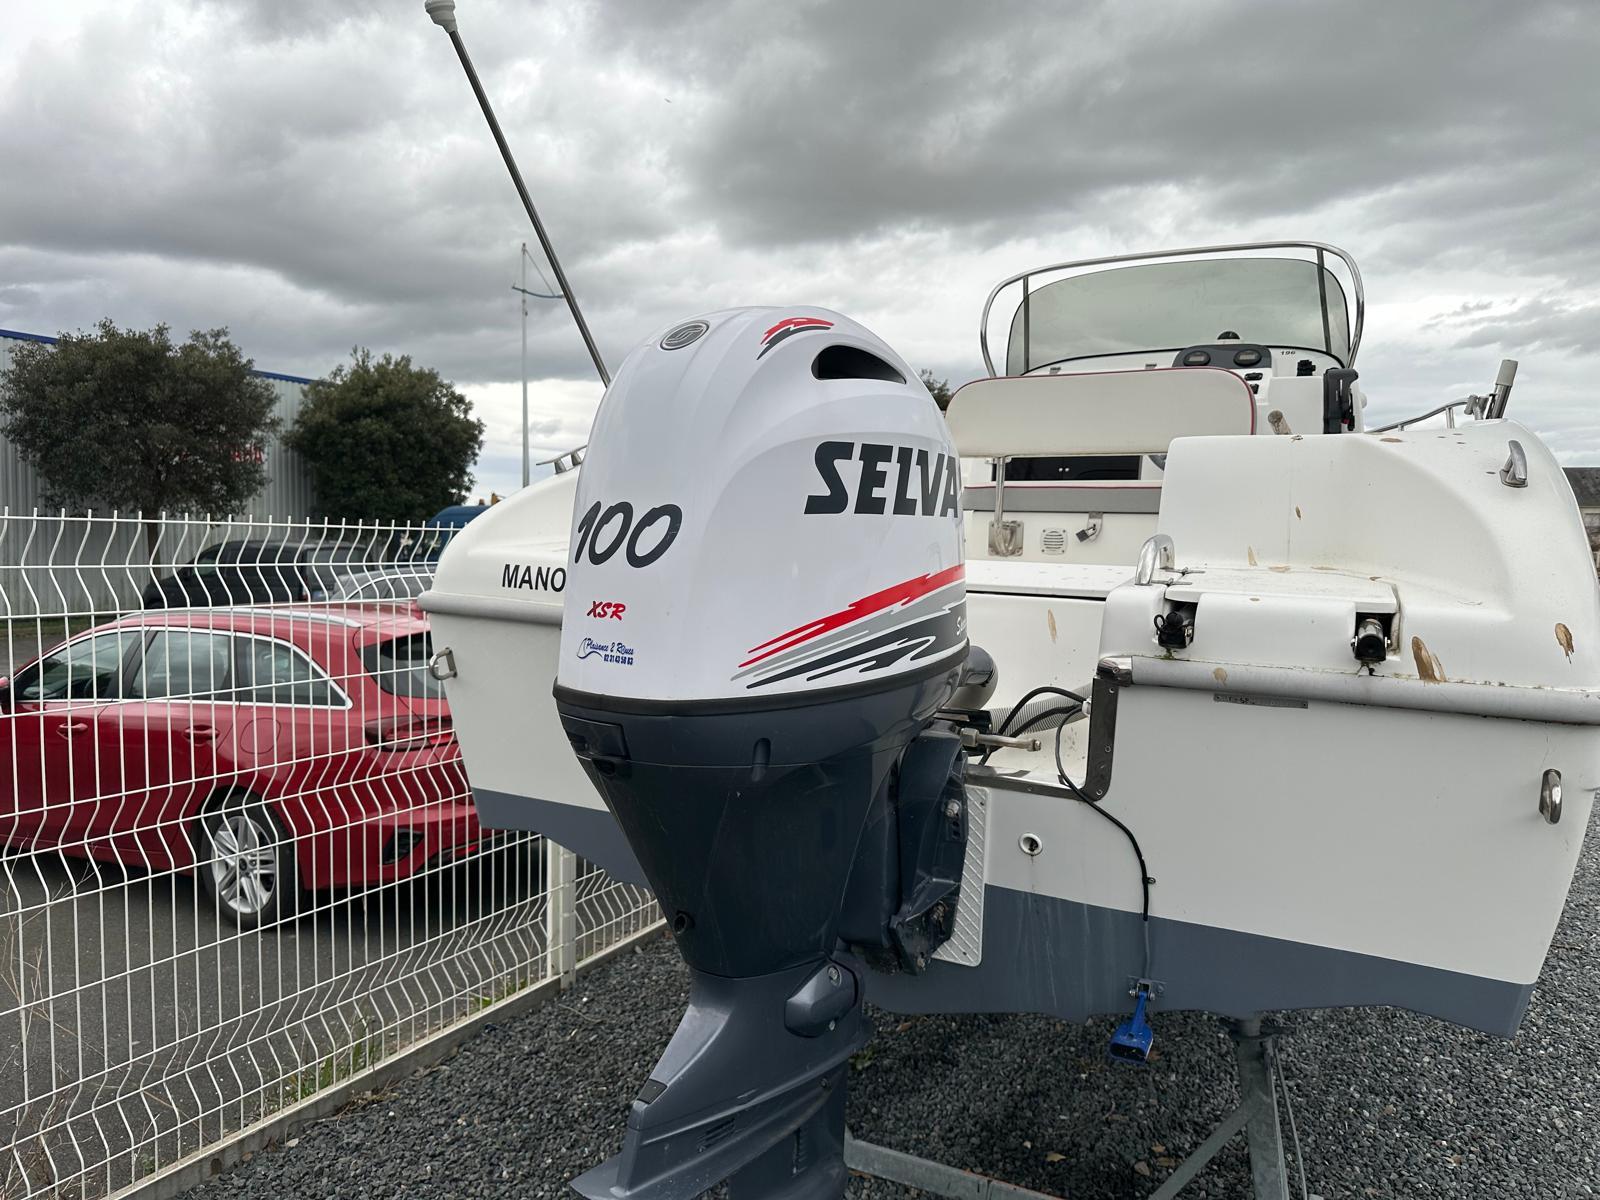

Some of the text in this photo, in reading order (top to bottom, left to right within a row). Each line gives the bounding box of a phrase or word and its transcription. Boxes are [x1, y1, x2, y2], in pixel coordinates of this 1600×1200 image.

[804, 441, 961, 519] SELVA
[575, 500, 682, 569] 100
[502, 564, 566, 592] MANO
[587, 600, 625, 620] XSR
[610, 642, 616, 653] 2
